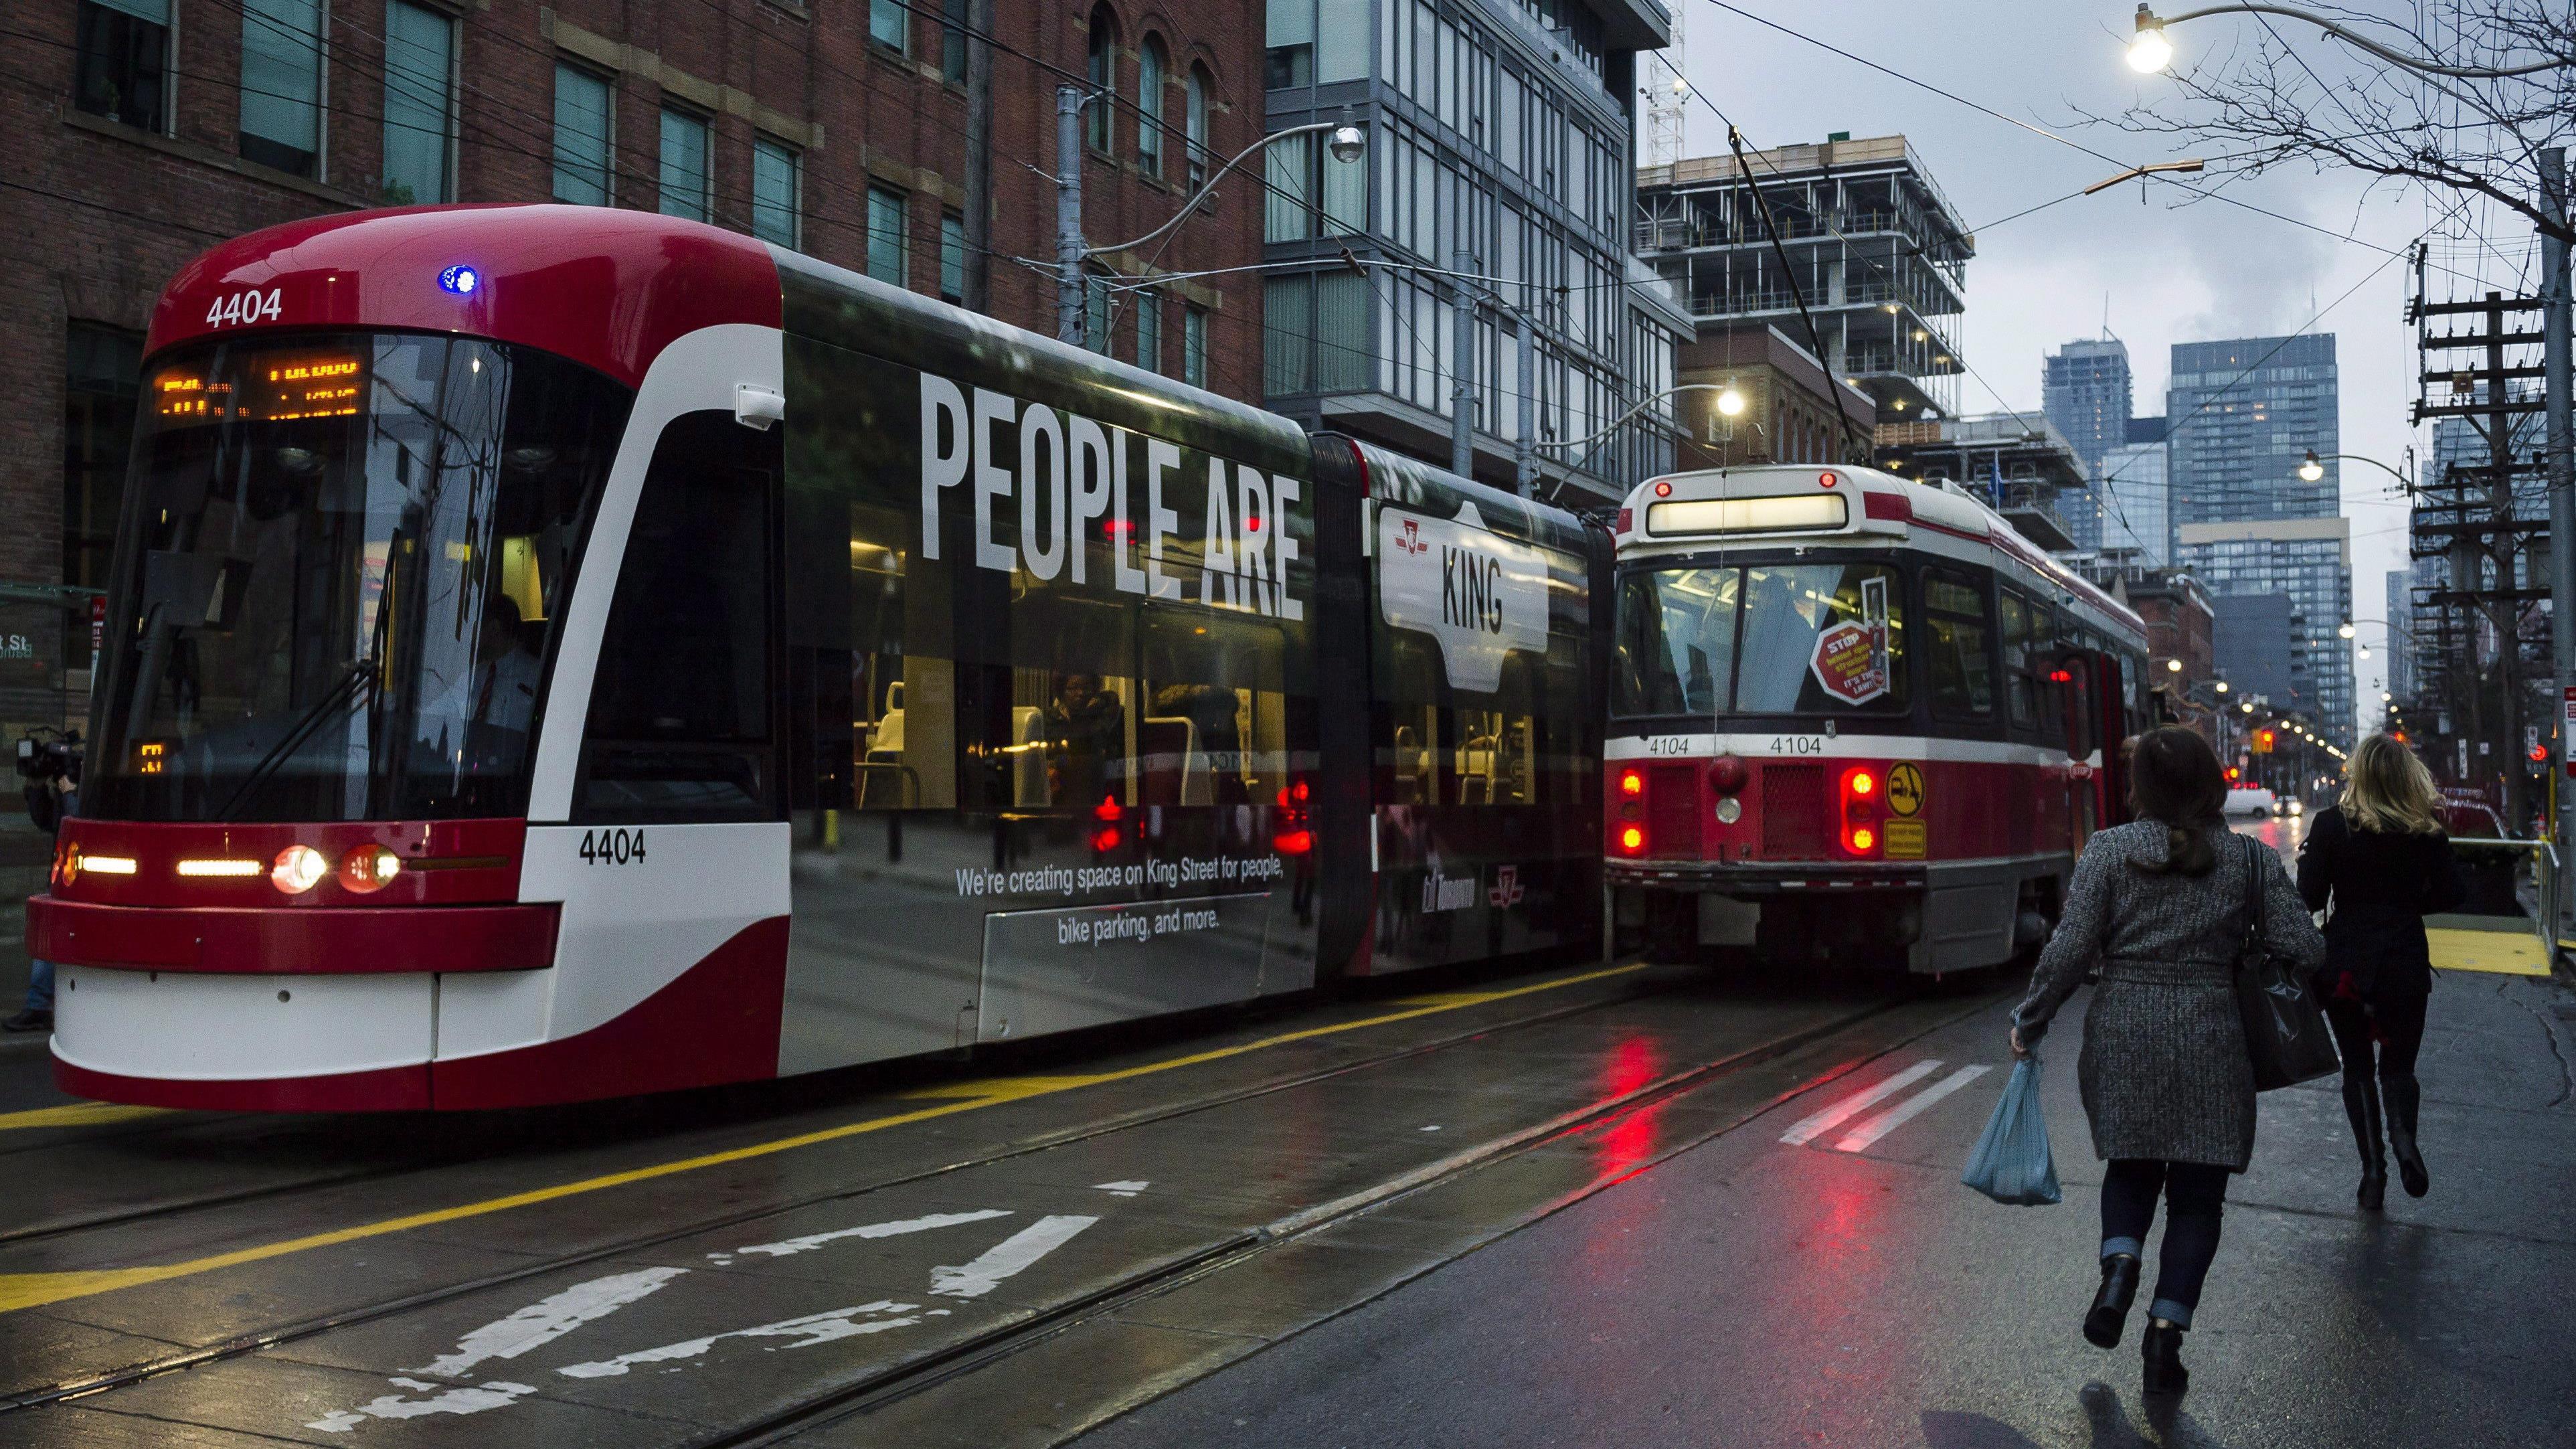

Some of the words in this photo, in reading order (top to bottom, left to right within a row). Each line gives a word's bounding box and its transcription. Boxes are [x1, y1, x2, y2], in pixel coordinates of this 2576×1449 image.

[206, 288, 282, 328] 4404
[920, 372, 1182, 601] PEOPLE
[1201, 456, 1304, 621] ARE
[1442, 545, 1502, 635] KING
[9, 634, 27, 651] St
[1827, 633, 1860, 654] STOP
[1650, 738, 1689, 754] 4104
[1771, 737, 1821, 754] 4104
[580, 828, 646, 865] 4404
[956, 867, 1004, 896] We're
[1009, 864, 1073, 896] creating
[1078, 867, 1121, 893] space
[1125, 865, 1142, 885] on
[1147, 859, 1177, 887] King
[1181, 857, 1218, 881] Street
[1222, 855, 1238, 878] for
[1241, 853, 1283, 883] people,
[1058, 917, 1090, 944] bike
[1094, 912, 1151, 946] parking,
[1155, 908, 1180, 934] and
[1184, 910, 1219, 930] more.
